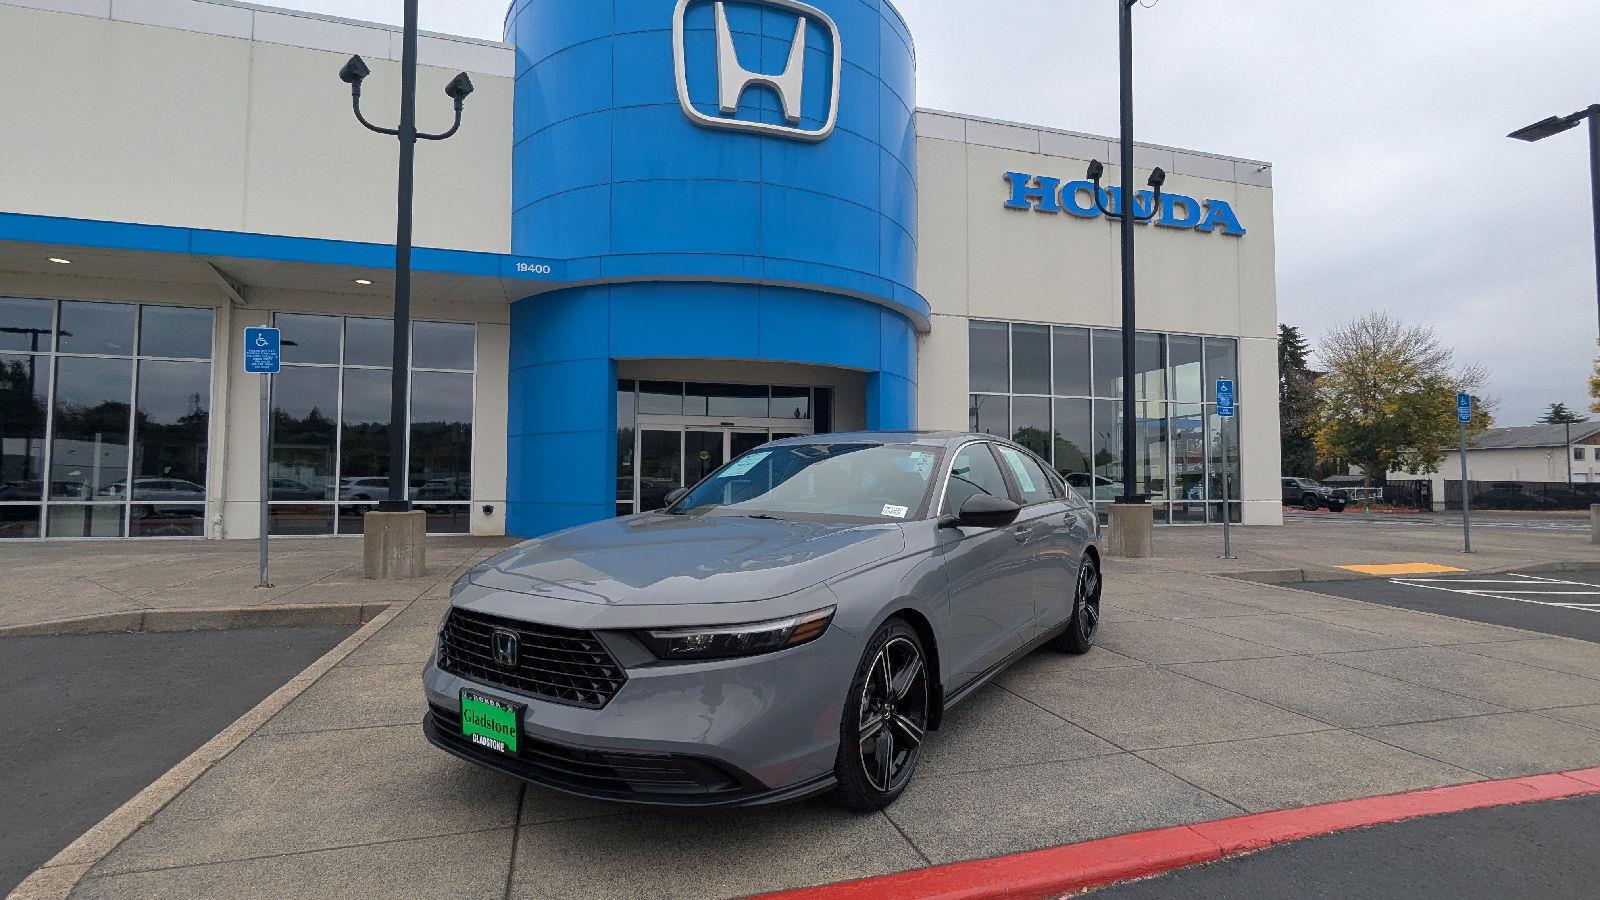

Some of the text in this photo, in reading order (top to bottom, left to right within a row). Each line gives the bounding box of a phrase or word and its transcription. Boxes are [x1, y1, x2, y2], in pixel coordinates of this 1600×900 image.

[1003, 171, 1247, 237] HONDA
[515, 262, 551, 274] 19400
[463, 708, 516, 738] Gladstone
[472, 733, 505, 753] GLADSTONE
